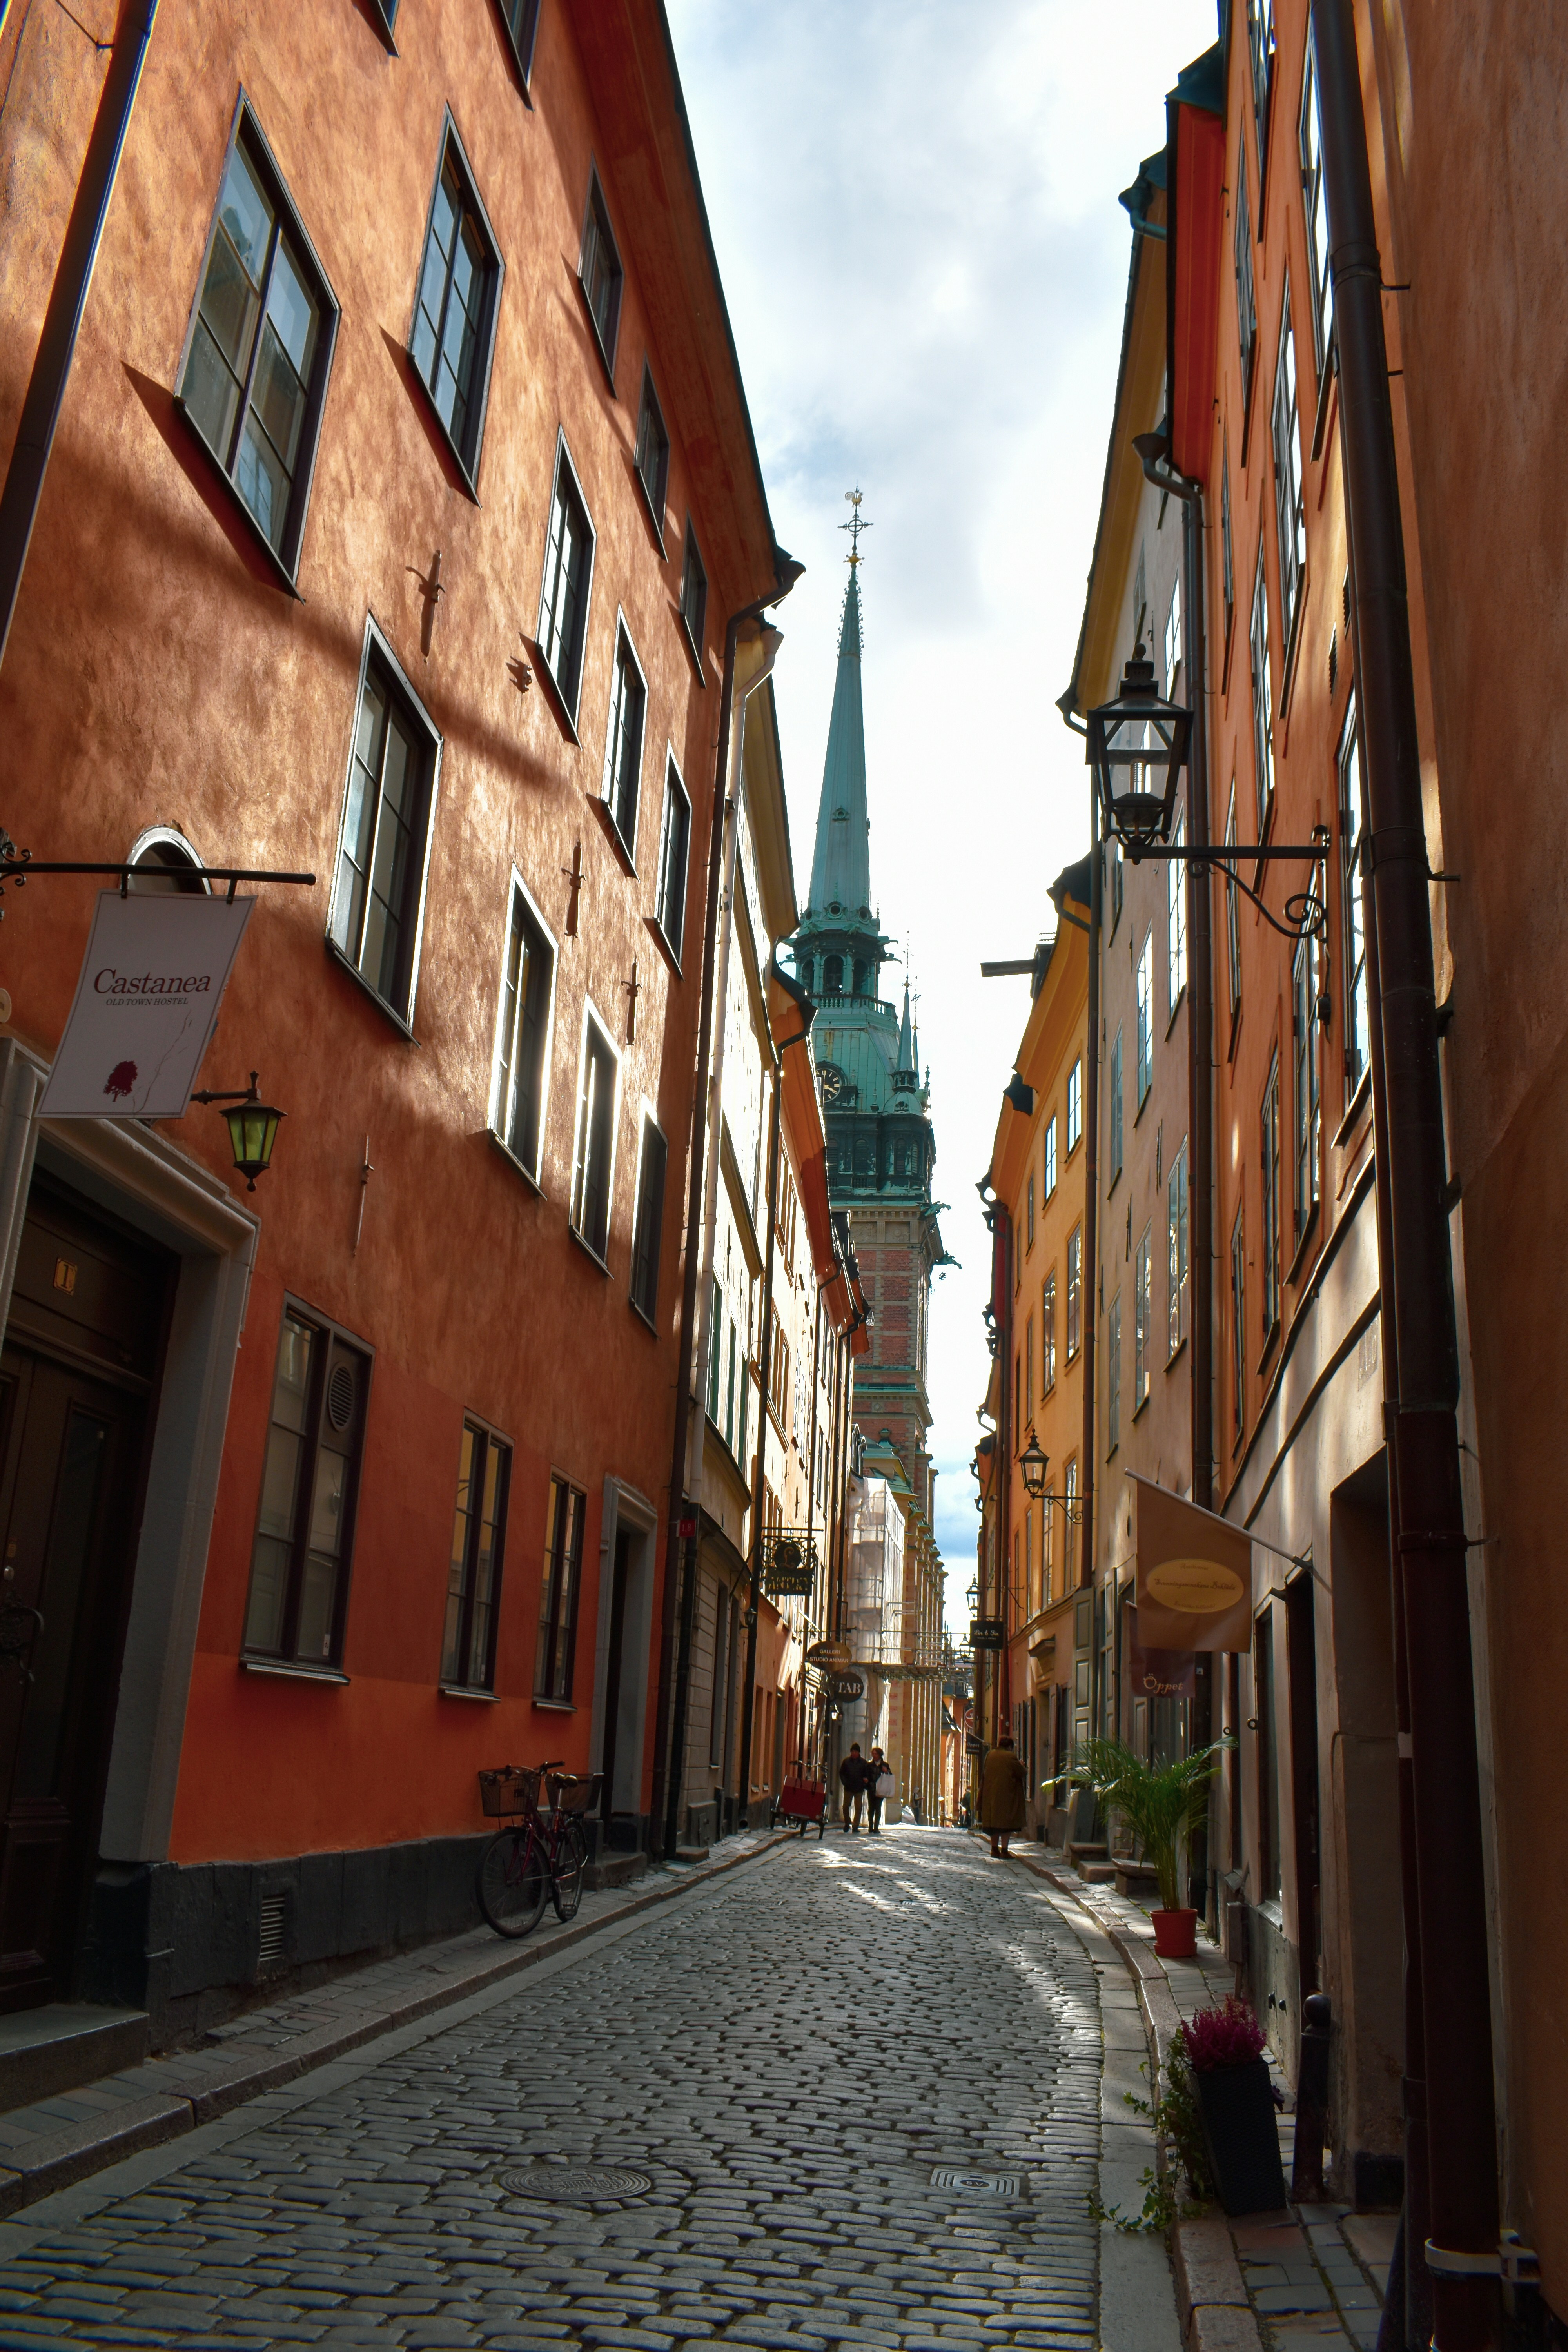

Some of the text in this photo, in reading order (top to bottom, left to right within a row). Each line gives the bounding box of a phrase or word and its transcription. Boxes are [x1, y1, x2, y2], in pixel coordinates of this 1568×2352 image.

[94, 969, 211, 994] Castanea
[682, 1523, 691, 1532] 1,8
[1143, 1673, 1183, 1694] Öppet
